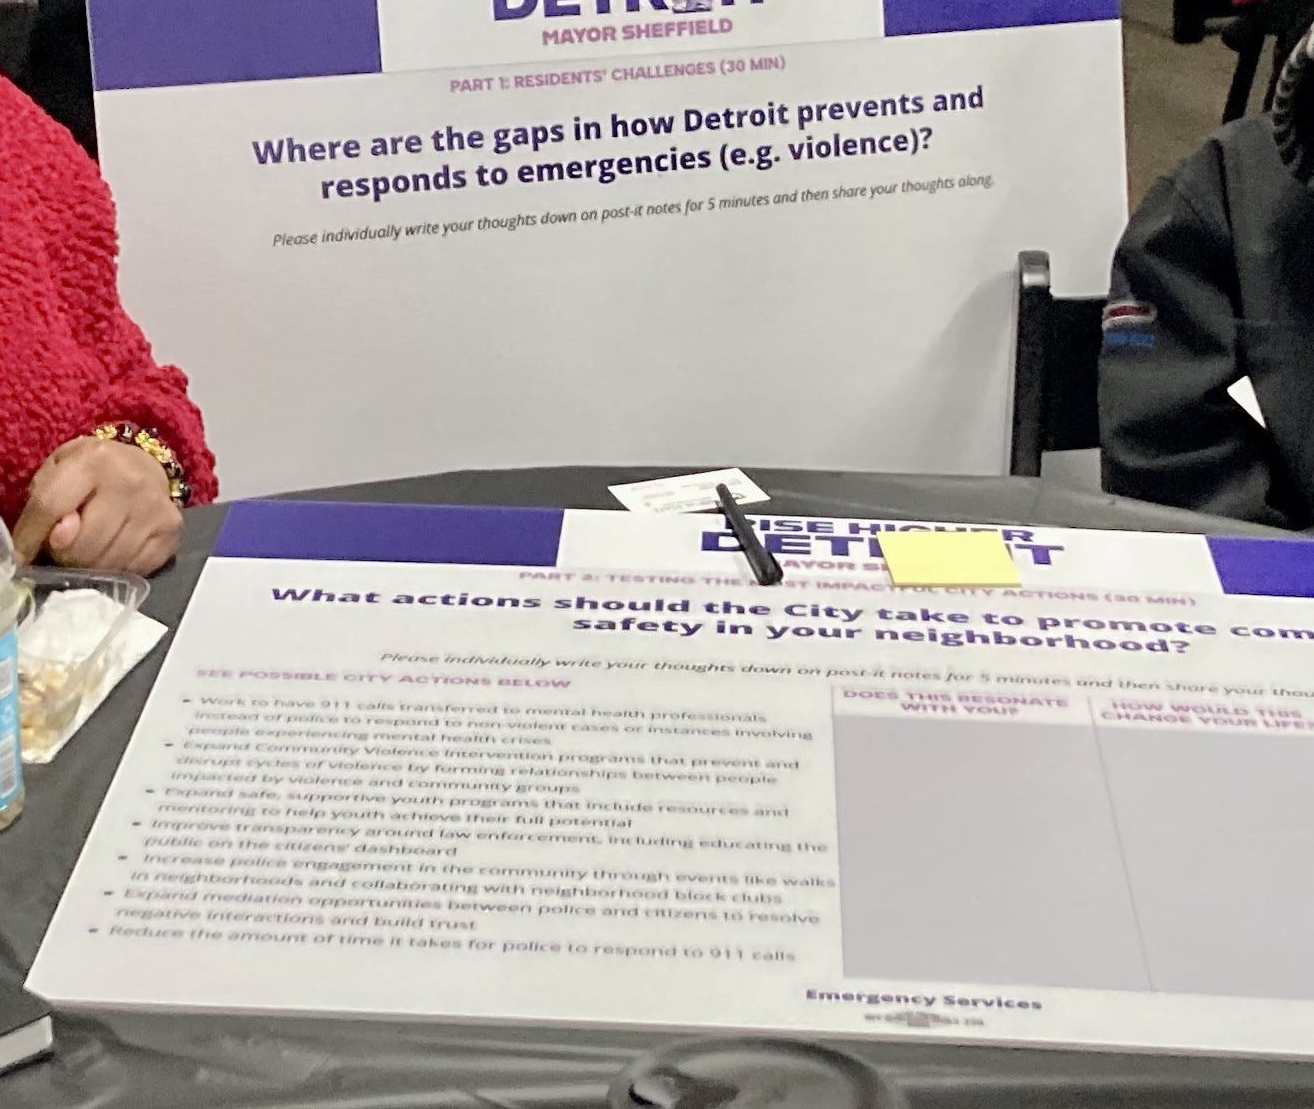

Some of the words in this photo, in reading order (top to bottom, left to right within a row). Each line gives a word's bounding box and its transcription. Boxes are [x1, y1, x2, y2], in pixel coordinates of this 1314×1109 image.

[542, 24, 617, 46] MAYOR
[621, 17, 734, 41] SHEFFIELD
[449, 77, 494, 92] PART
[498, 76, 510, 89] 1:
[513, 69, 606, 87] RESIDENTS'
[610, 61, 716, 80] CHALLENGES
[720, 57, 746, 76] (30
[749, 55, 785, 70] MIN)
[251, 138, 360, 163] Where
[370, 135, 422, 155] are
[430, 126, 484, 151] the
[492, 124, 564, 153] gaps
[573, 116, 602, 140] in
[610, 114, 675, 137] how
[684, 102, 789, 131] Detroit
[797, 95, 924, 129] prevents
[932, 85, 983, 111] and
[321, 165, 466, 202] responds
[474, 165, 508, 186] to
[517, 148, 711, 183] emergencies
[719, 144, 780, 170] (e.g.
[787, 128, 932, 159] violence)?
[272, 233, 318, 246] Please
[321, 225, 402, 242] individually
[404, 222, 440, 235] write
[441, 220, 474, 237] your
[477, 214, 537, 231] thoughts
[540, 211, 577, 224] down
[580, 209, 598, 221] on
[600, 205, 643, 223] post-it
[646, 202, 682, 215] notes
[682, 199, 704, 216] for
[707, 197, 715, 210] 5
[718, 195, 769, 208] minutes
[772, 190, 798, 204] and
[800, 189, 829, 202] then
[832, 186, 867, 198] share
[868, 183, 898, 199] your
[901, 178, 954, 193] thoughts
[778, 559, 855, 572] AYOR
[271, 588, 380, 602] What
[391, 593, 540, 607] actions
[553, 597, 689, 613] should
[704, 601, 771, 617] the
[784, 604, 863, 622] City
[876, 608, 969, 624] take
[983, 613, 1024, 627] to
[1038, 616, 1216, 635] promote
[572, 617, 703, 636] safety
[716, 620, 752, 634] in
[765, 625, 862, 639] your
[875, 629, 1189, 652] neighborhood?
[196, 668, 233, 678] SEE
[237, 669, 338, 681] POSSIBLE
[342, 671, 393, 683] CITY
[397, 672, 492, 686] ACTIONS
[496, 676, 572, 689] BELOW
[378, 651, 440, 663] Please
[443, 653, 551, 668] individually
[554, 657, 602, 668] write
[604, 659, 650, 674] your
[652, 660, 736, 676] thoughts
[739, 663, 793, 676] down
[795, 665, 822, 676] on
[889, 669, 942, 681] notes
[943, 670, 975, 684] for
[994, 674, 1071, 686] minutes
[1075, 676, 1113, 689] and
[1116, 678, 1161, 690] then
[1165, 682, 1219, 694] share
[1221, 684, 1266, 697] your
[806, 989, 936, 1007] Emergency
[942, 995, 1042, 1009] Services
